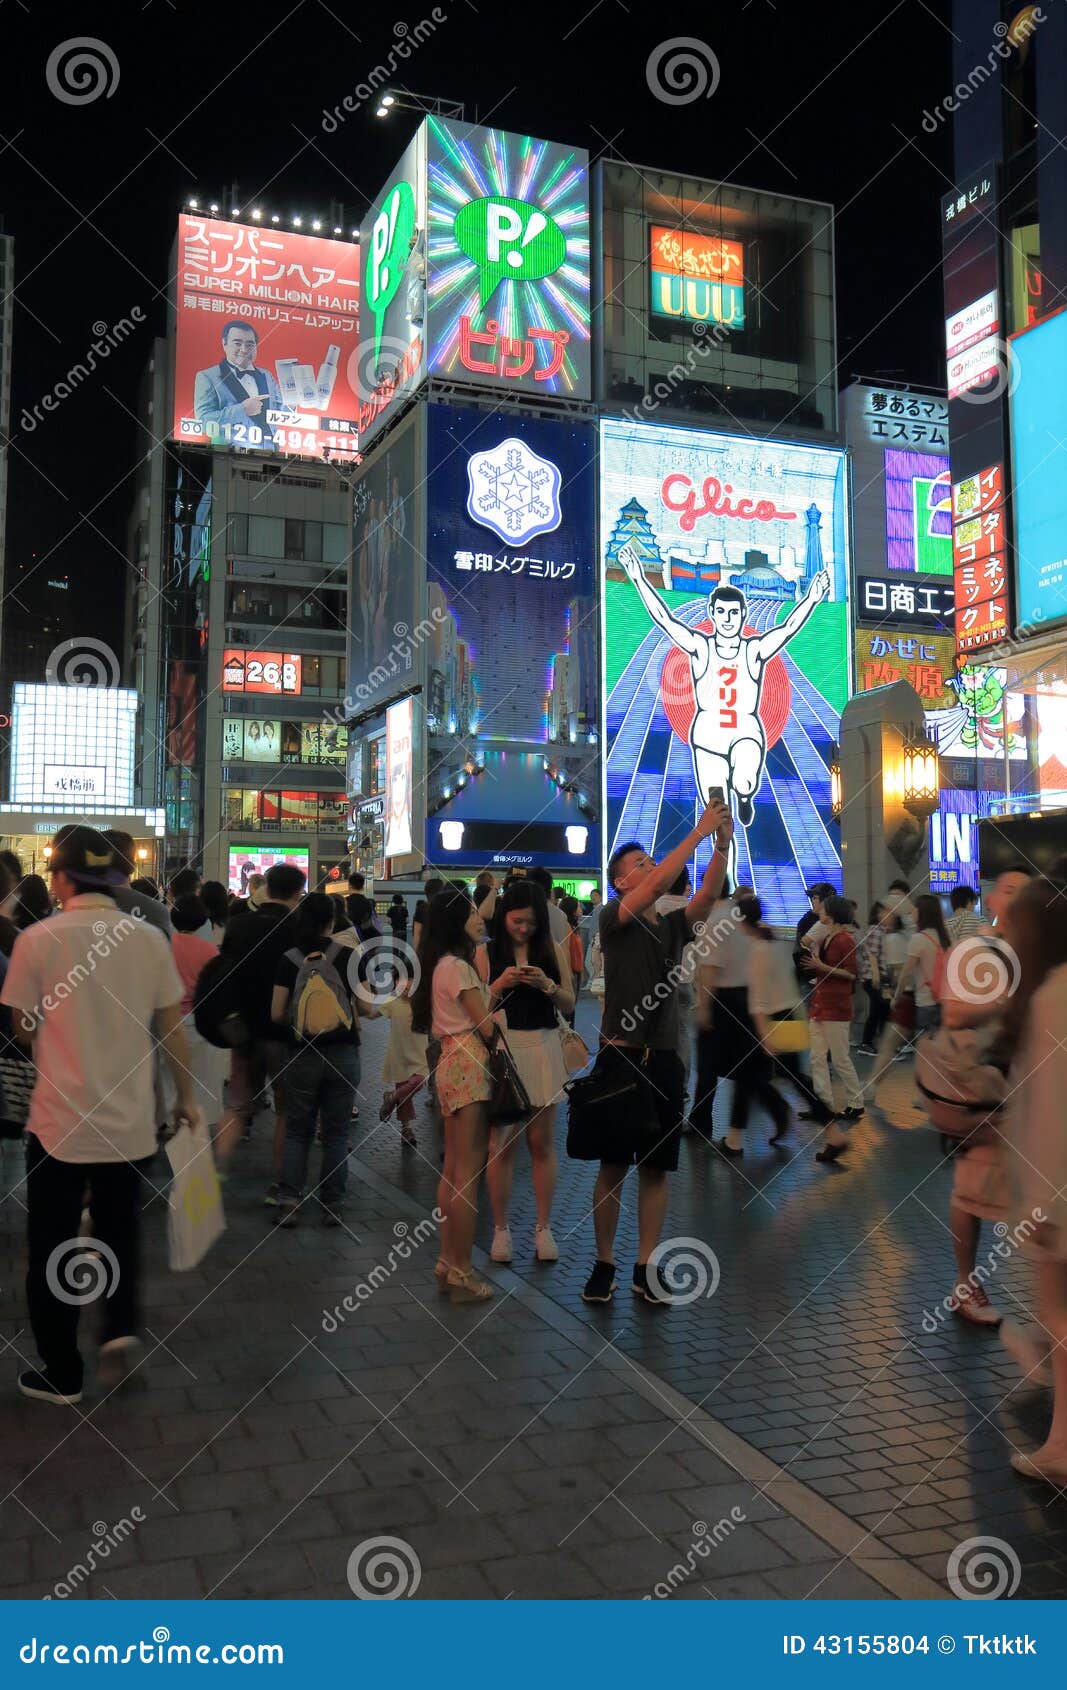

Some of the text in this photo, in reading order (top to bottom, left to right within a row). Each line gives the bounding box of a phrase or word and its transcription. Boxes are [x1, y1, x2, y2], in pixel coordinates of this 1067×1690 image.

[945, 179, 991, 221] 戎橋ビル
[184, 220, 284, 254] スーパー
[487, 202, 547, 268] P!
[184, 246, 360, 288] ミリオンヘアー
[183, 294, 360, 334] 薄毛部分のボリュームアップ!
[184, 273, 360, 313] SUPER MILLION HAIR
[459, 315, 569, 381] ピップ
[205, 420, 359, 454] 0120-494-111
[269, 412, 302, 425] ルアン
[871, 420, 946, 446] エステム
[661, 473, 797, 531] Glico
[453, 551, 576, 580] 雪印メグミルク
[980, 465, 1006, 625] インターネット
[958, 543, 981, 629] コミック
[869, 636, 937, 661] かぜに
[717, 664, 738, 728] グリコ
[932, 812, 978, 863] IN
